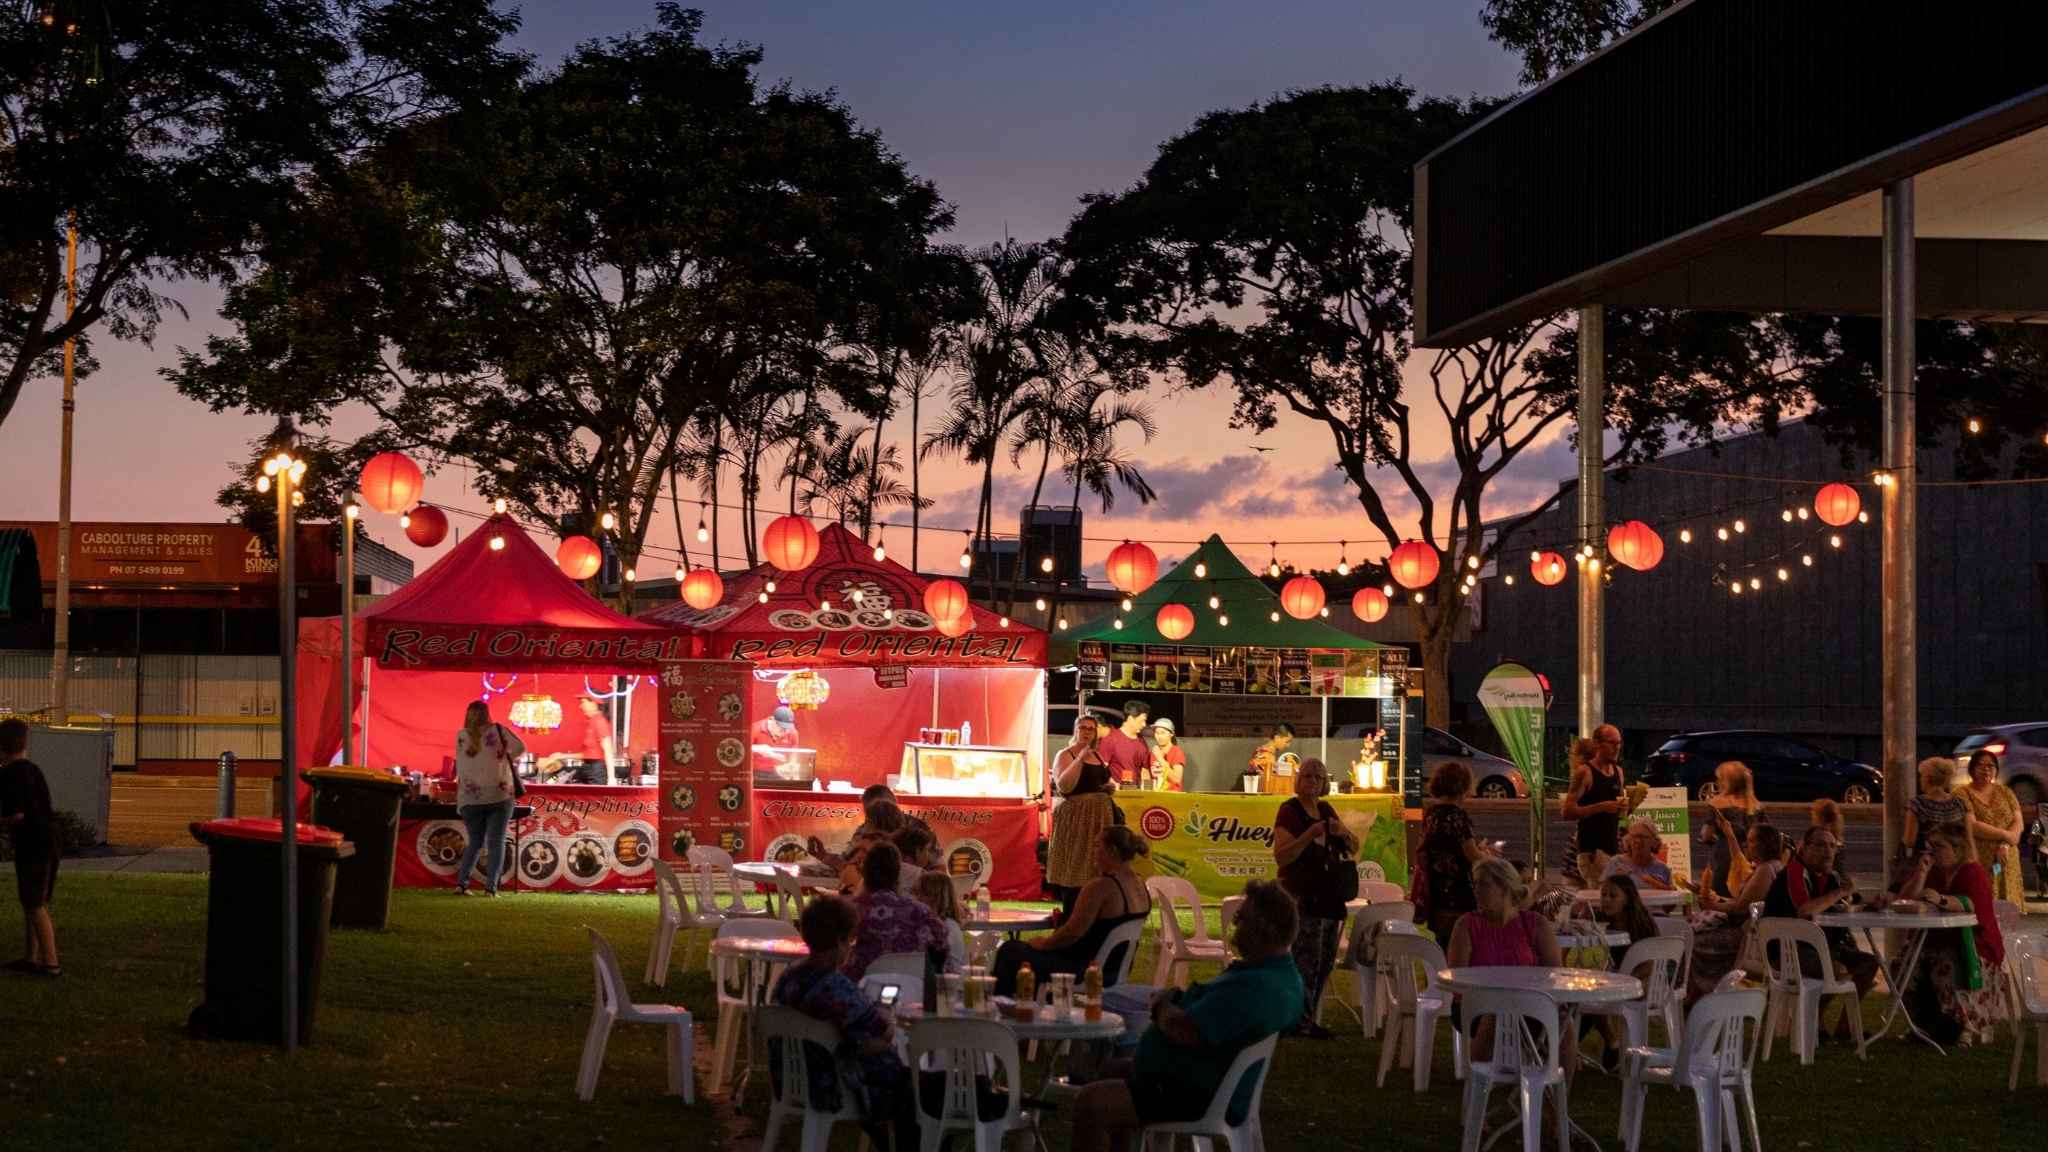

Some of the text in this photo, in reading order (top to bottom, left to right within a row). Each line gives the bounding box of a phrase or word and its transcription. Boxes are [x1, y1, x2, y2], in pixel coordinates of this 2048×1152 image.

[80, 532, 214, 546] CABOOLTURE PROPERTY
[80, 545, 160, 556] MANAGEMENT
[379, 628, 681, 664] Red Oriental
[731, 631, 828, 662] Red
[528, 795, 659, 818] Dumplings
[763, 800, 861, 819] Chinese
[1207, 816, 1275, 848] Huey
[1358, 866, 1382, 879] 00%
